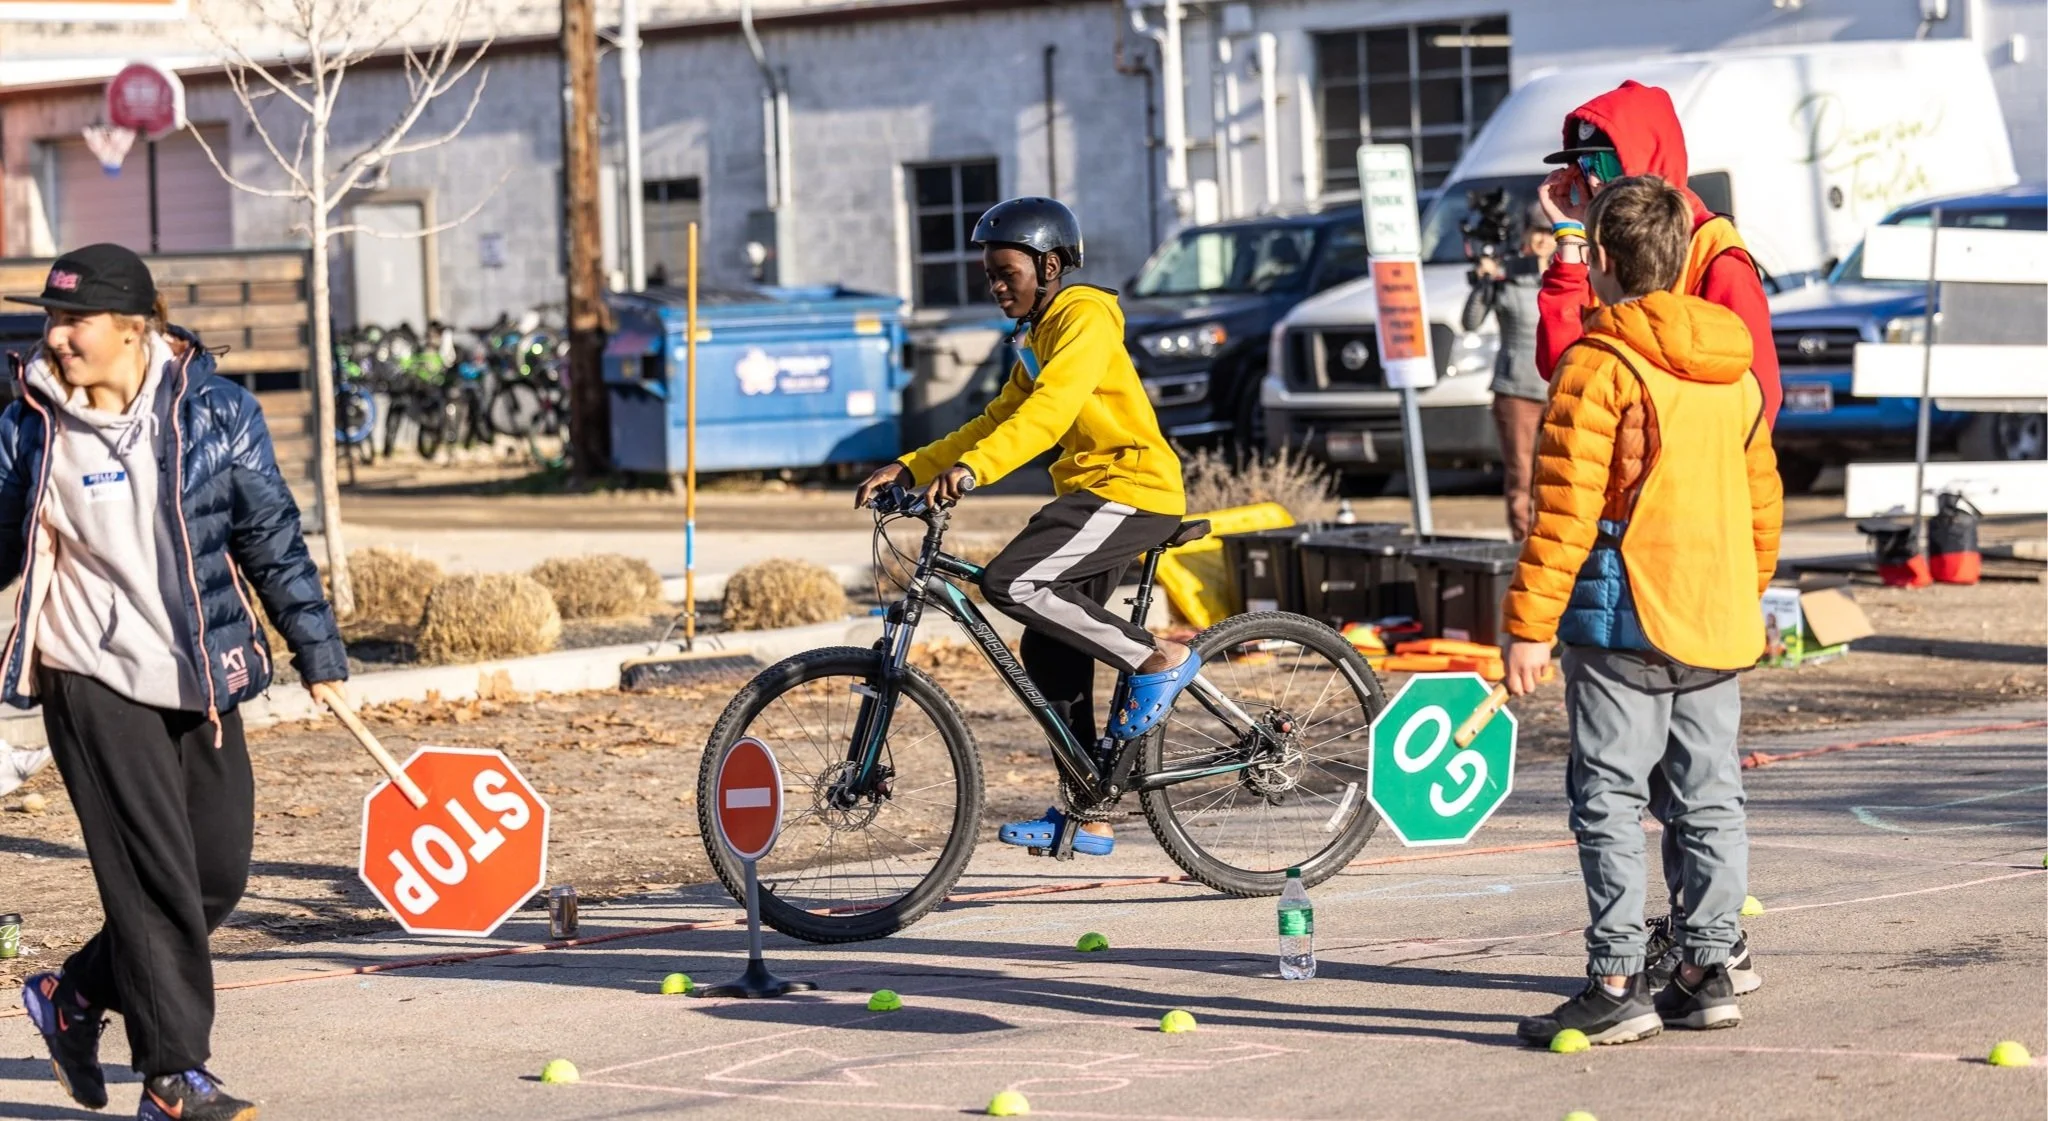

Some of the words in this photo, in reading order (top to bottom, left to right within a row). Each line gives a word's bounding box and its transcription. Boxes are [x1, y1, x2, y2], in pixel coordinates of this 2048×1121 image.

[970, 622, 1048, 707] SPECIALIZED
[1393, 704, 1488, 817] GO
[387, 769, 530, 915] STOP
